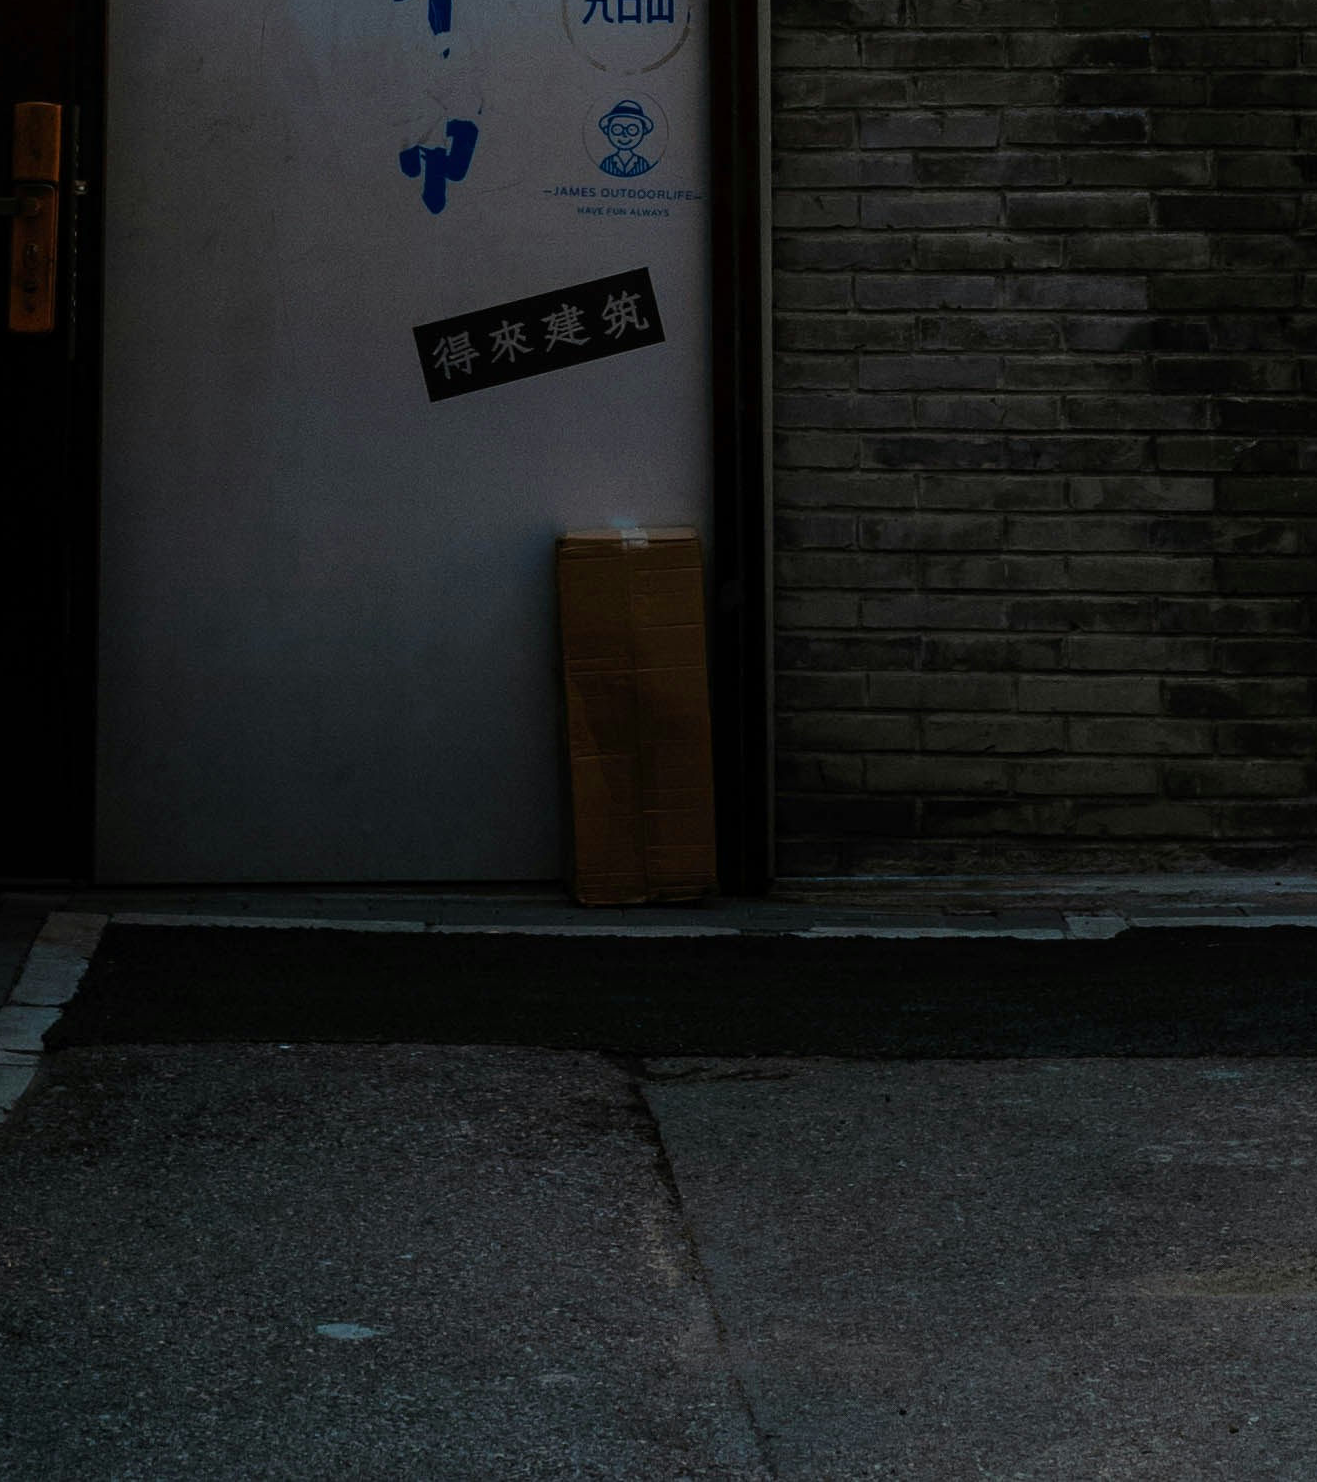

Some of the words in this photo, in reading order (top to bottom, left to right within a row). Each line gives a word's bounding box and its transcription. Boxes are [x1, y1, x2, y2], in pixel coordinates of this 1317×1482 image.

[553, 186, 597, 198] JAMES
[577, 206, 604, 216] HAVE
[606, 207, 627, 216] FUN
[629, 207, 670, 218] ALWAYS
[431, 287, 651, 381] 得來建筑
